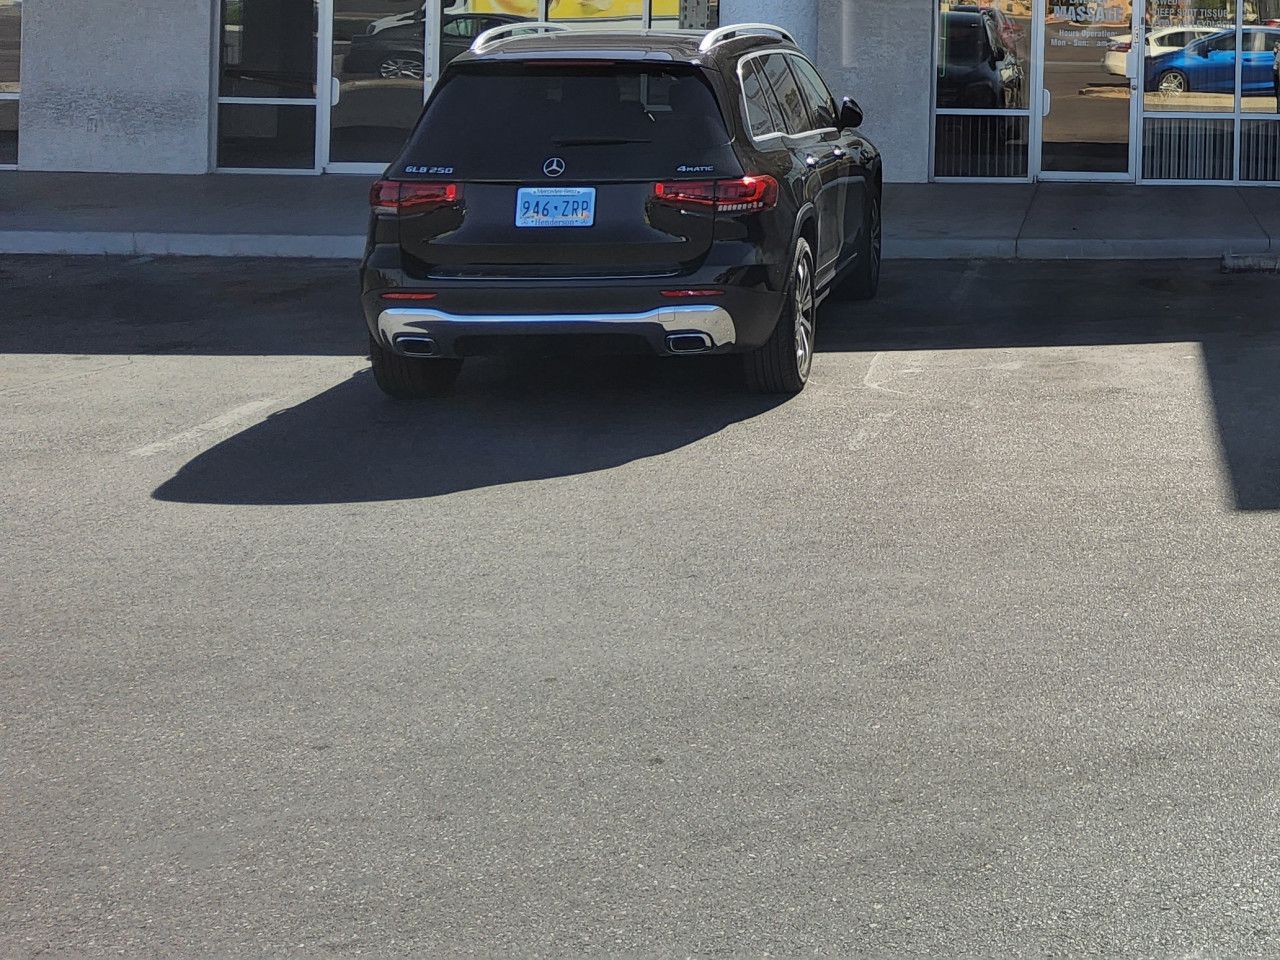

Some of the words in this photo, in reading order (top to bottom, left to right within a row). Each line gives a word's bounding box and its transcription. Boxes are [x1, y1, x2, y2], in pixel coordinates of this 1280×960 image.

[1200, 8, 1228, 18] TISSUE
[405, 165, 427, 173] GLB
[522, 200, 550, 217] 946
[561, 200, 589, 217] ZRP
